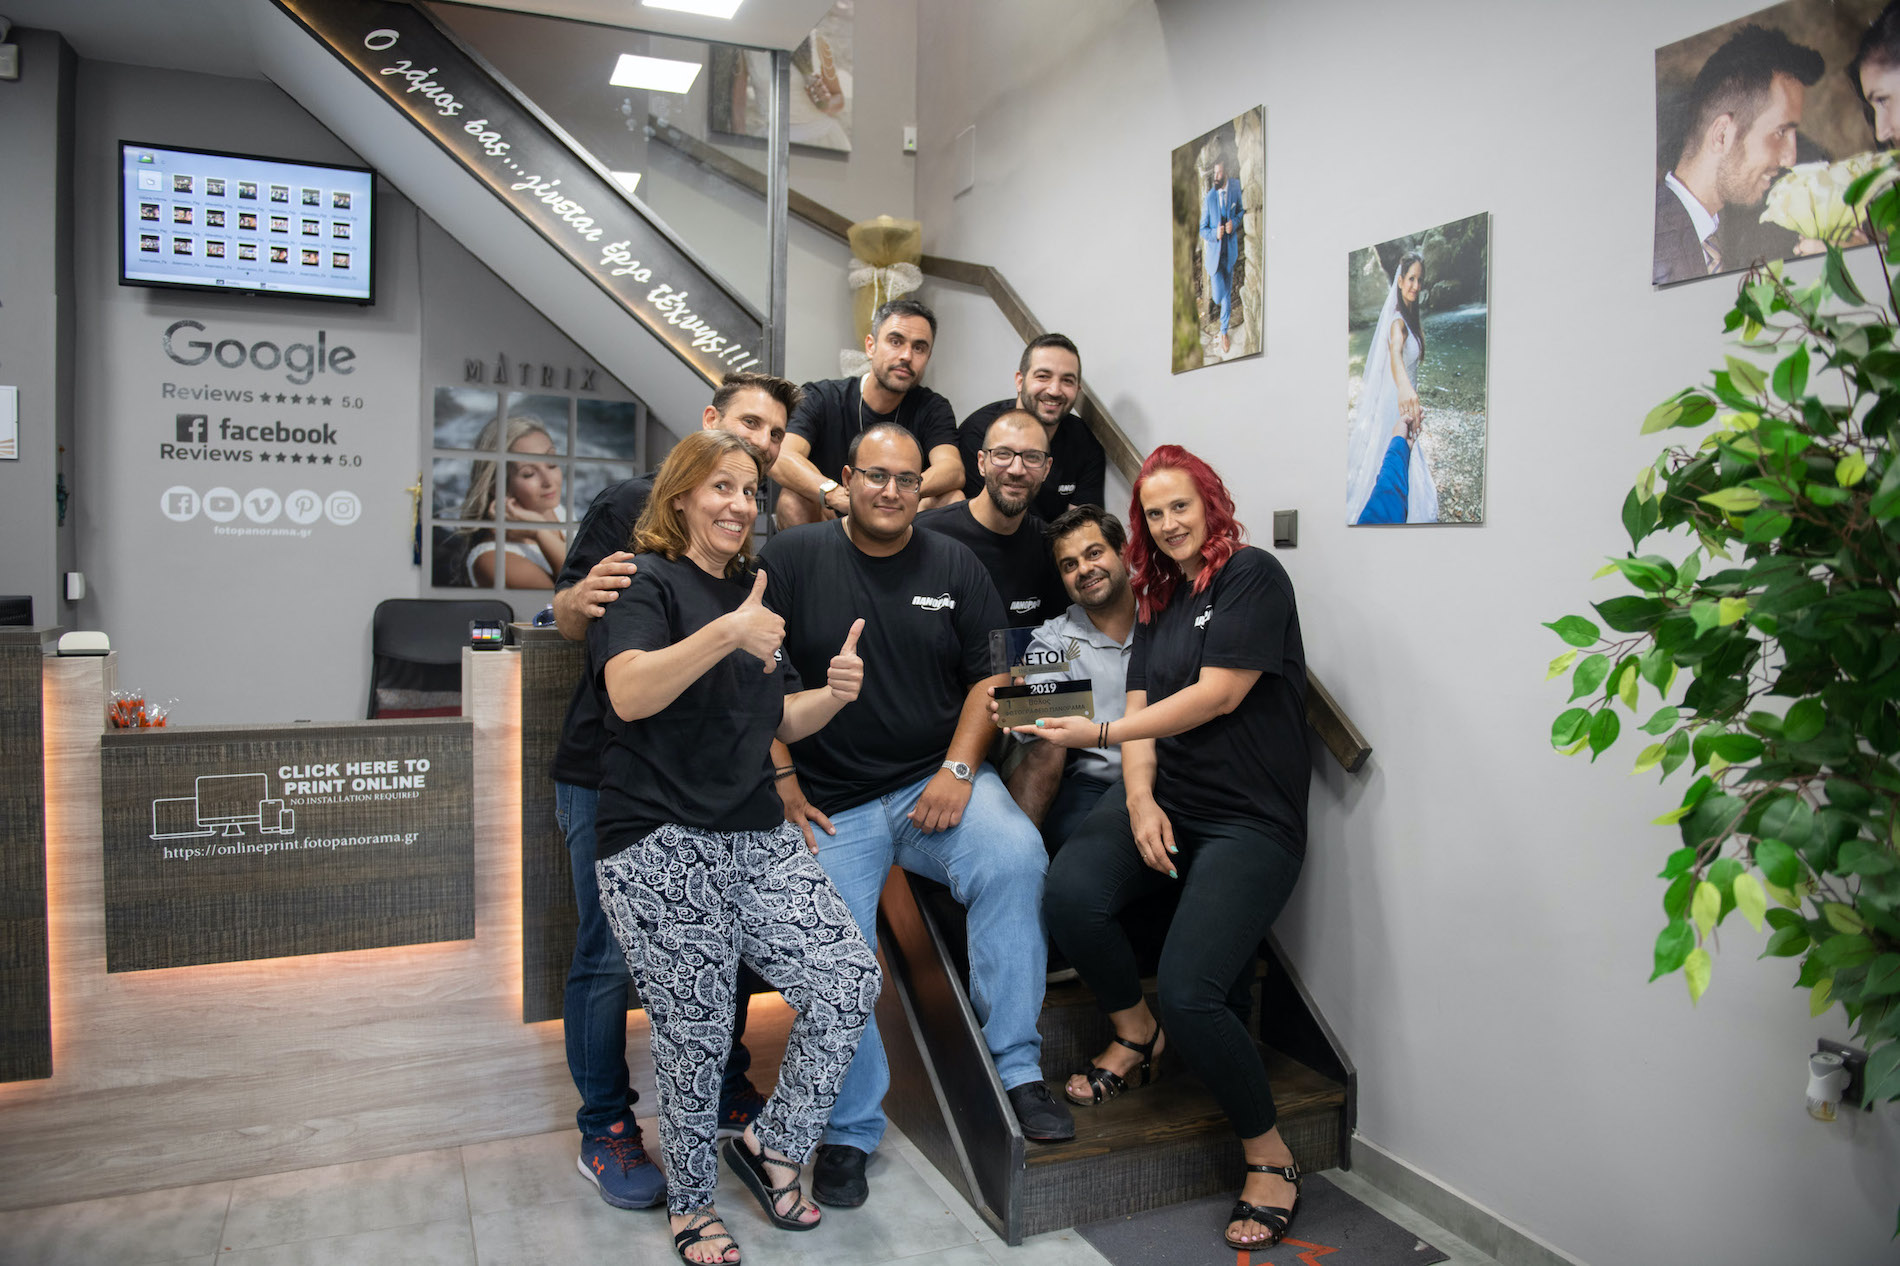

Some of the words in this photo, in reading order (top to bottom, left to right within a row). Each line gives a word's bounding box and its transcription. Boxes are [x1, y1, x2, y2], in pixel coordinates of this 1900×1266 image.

[162, 319, 356, 385] Google
[464, 352, 597, 391] MATRIX
[161, 382, 254, 403] Reviews
[341, 396, 364, 409] 5.0
[219, 417, 338, 445] facebook
[160, 443, 253, 462] Reviews
[339, 455, 362, 467] 5.0
[214, 525, 312, 538] fotopanorama.gr
[1030, 682, 1057, 695] 2019
[278, 763, 340, 779] CLICK
[346, 760, 399, 776] HERE
[405, 758, 431, 773] TO
[284, 779, 346, 796] PRINT
[352, 775, 425, 792] ONLINE
[290, 798, 305, 806] NO
[307, 793, 373, 805] INSTALLATION
[374, 790, 420, 801] REQUIRED
[163, 831, 419, 861] https://onlineprint.fotopanorama.gr
